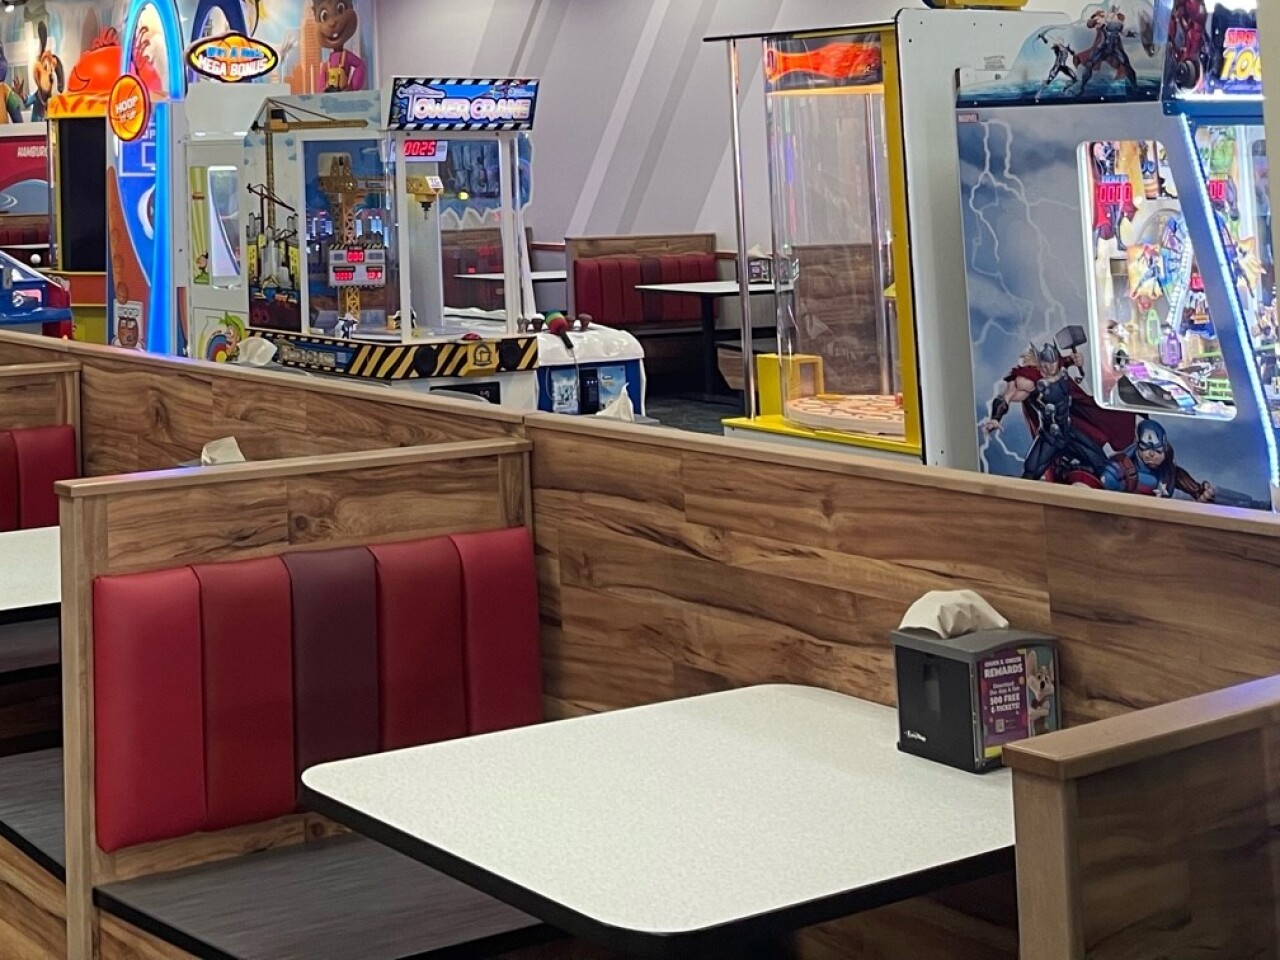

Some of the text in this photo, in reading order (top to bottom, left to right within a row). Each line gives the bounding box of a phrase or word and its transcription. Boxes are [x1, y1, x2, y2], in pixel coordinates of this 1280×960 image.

[198, 54, 269, 77] MEGA BONUS
[115, 95, 139, 114] HOOP
[396, 83, 471, 123] TOWER
[470, 97, 531, 122] CRANE
[404, 140, 436, 157] 0025
[984, 663, 1023, 678] REWARDS
[1004, 692, 1020, 703] FREE
